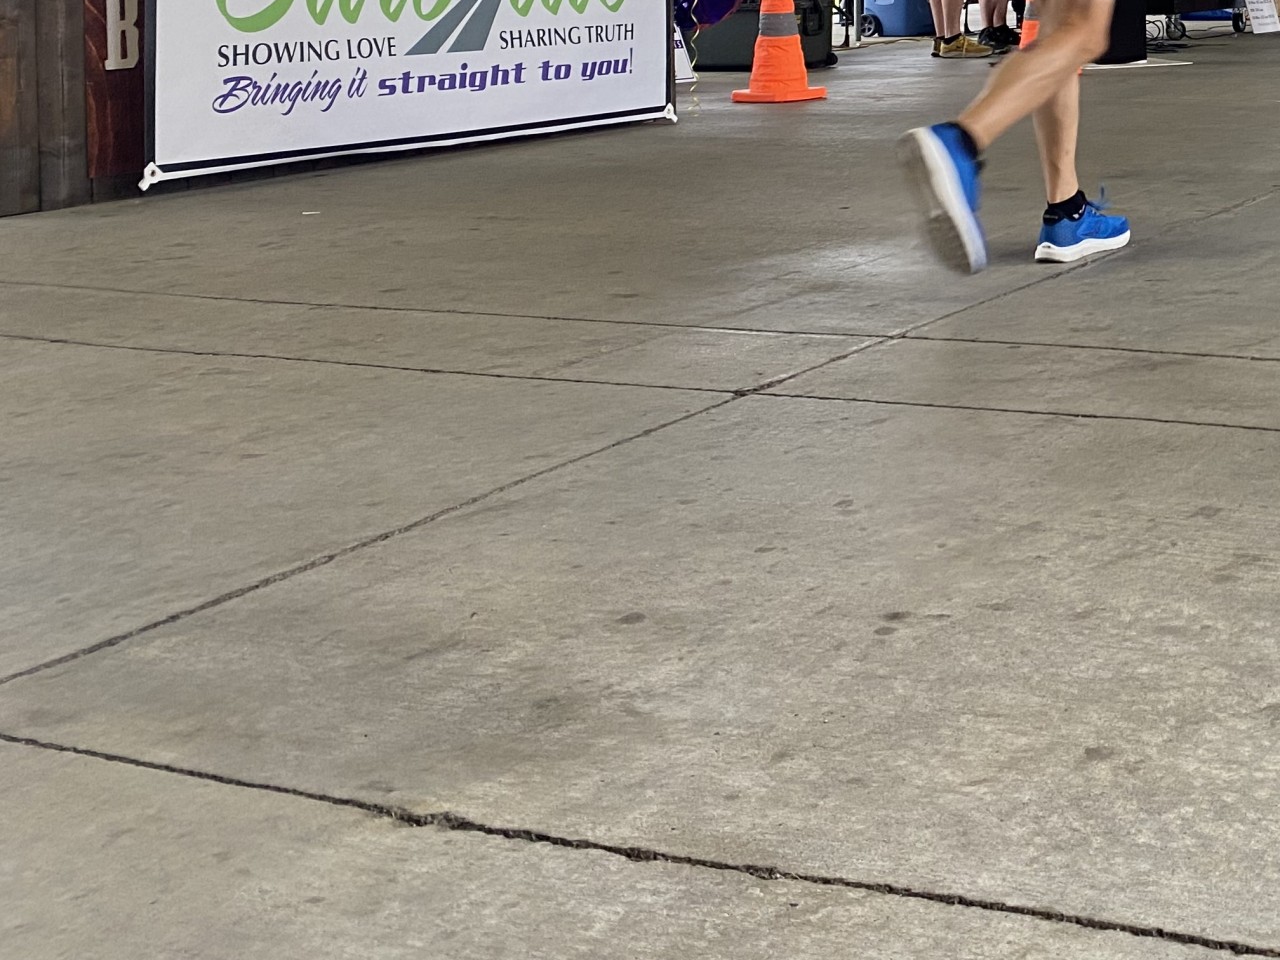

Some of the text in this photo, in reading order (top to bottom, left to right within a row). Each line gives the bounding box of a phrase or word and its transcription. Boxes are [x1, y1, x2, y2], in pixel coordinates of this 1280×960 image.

[216, 36, 397, 69] SHOWING LOVE
[499, 22, 635, 51] SHARING TRUTH
[212, 48, 635, 116] Bringing it straight to you!
